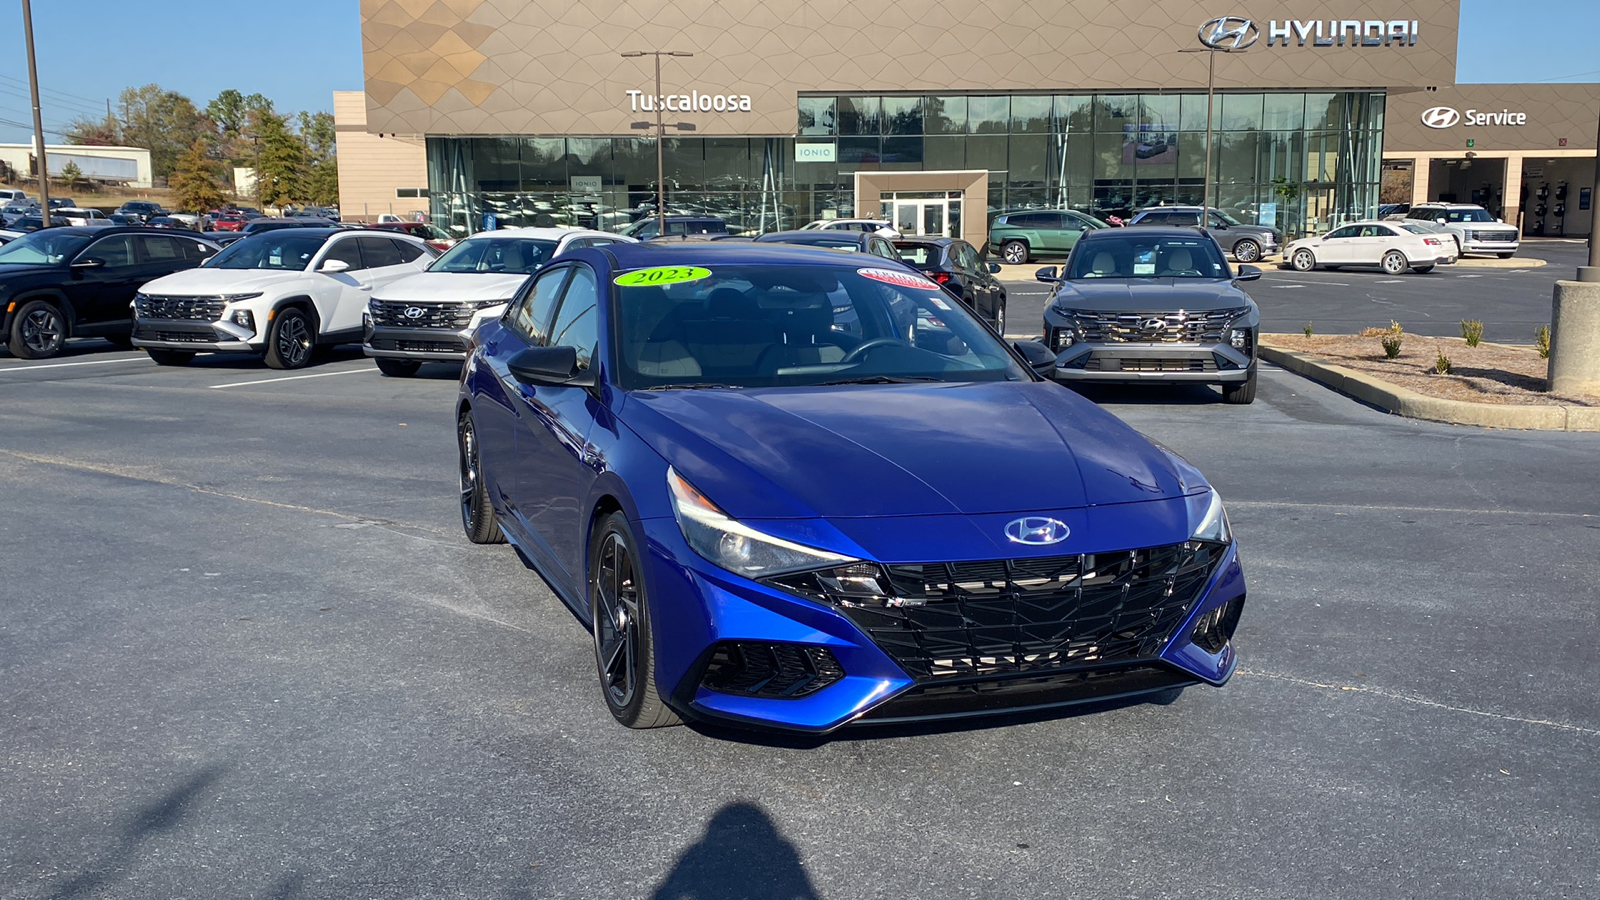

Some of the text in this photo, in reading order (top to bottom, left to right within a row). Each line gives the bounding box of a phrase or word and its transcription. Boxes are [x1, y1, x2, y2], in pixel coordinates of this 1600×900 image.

[1267, 20, 1418, 46] HYUNDAI
[626, 90, 751, 112] Tuscaloosa
[1464, 109, 1526, 126] Service
[632, 268, 694, 283] 2023
